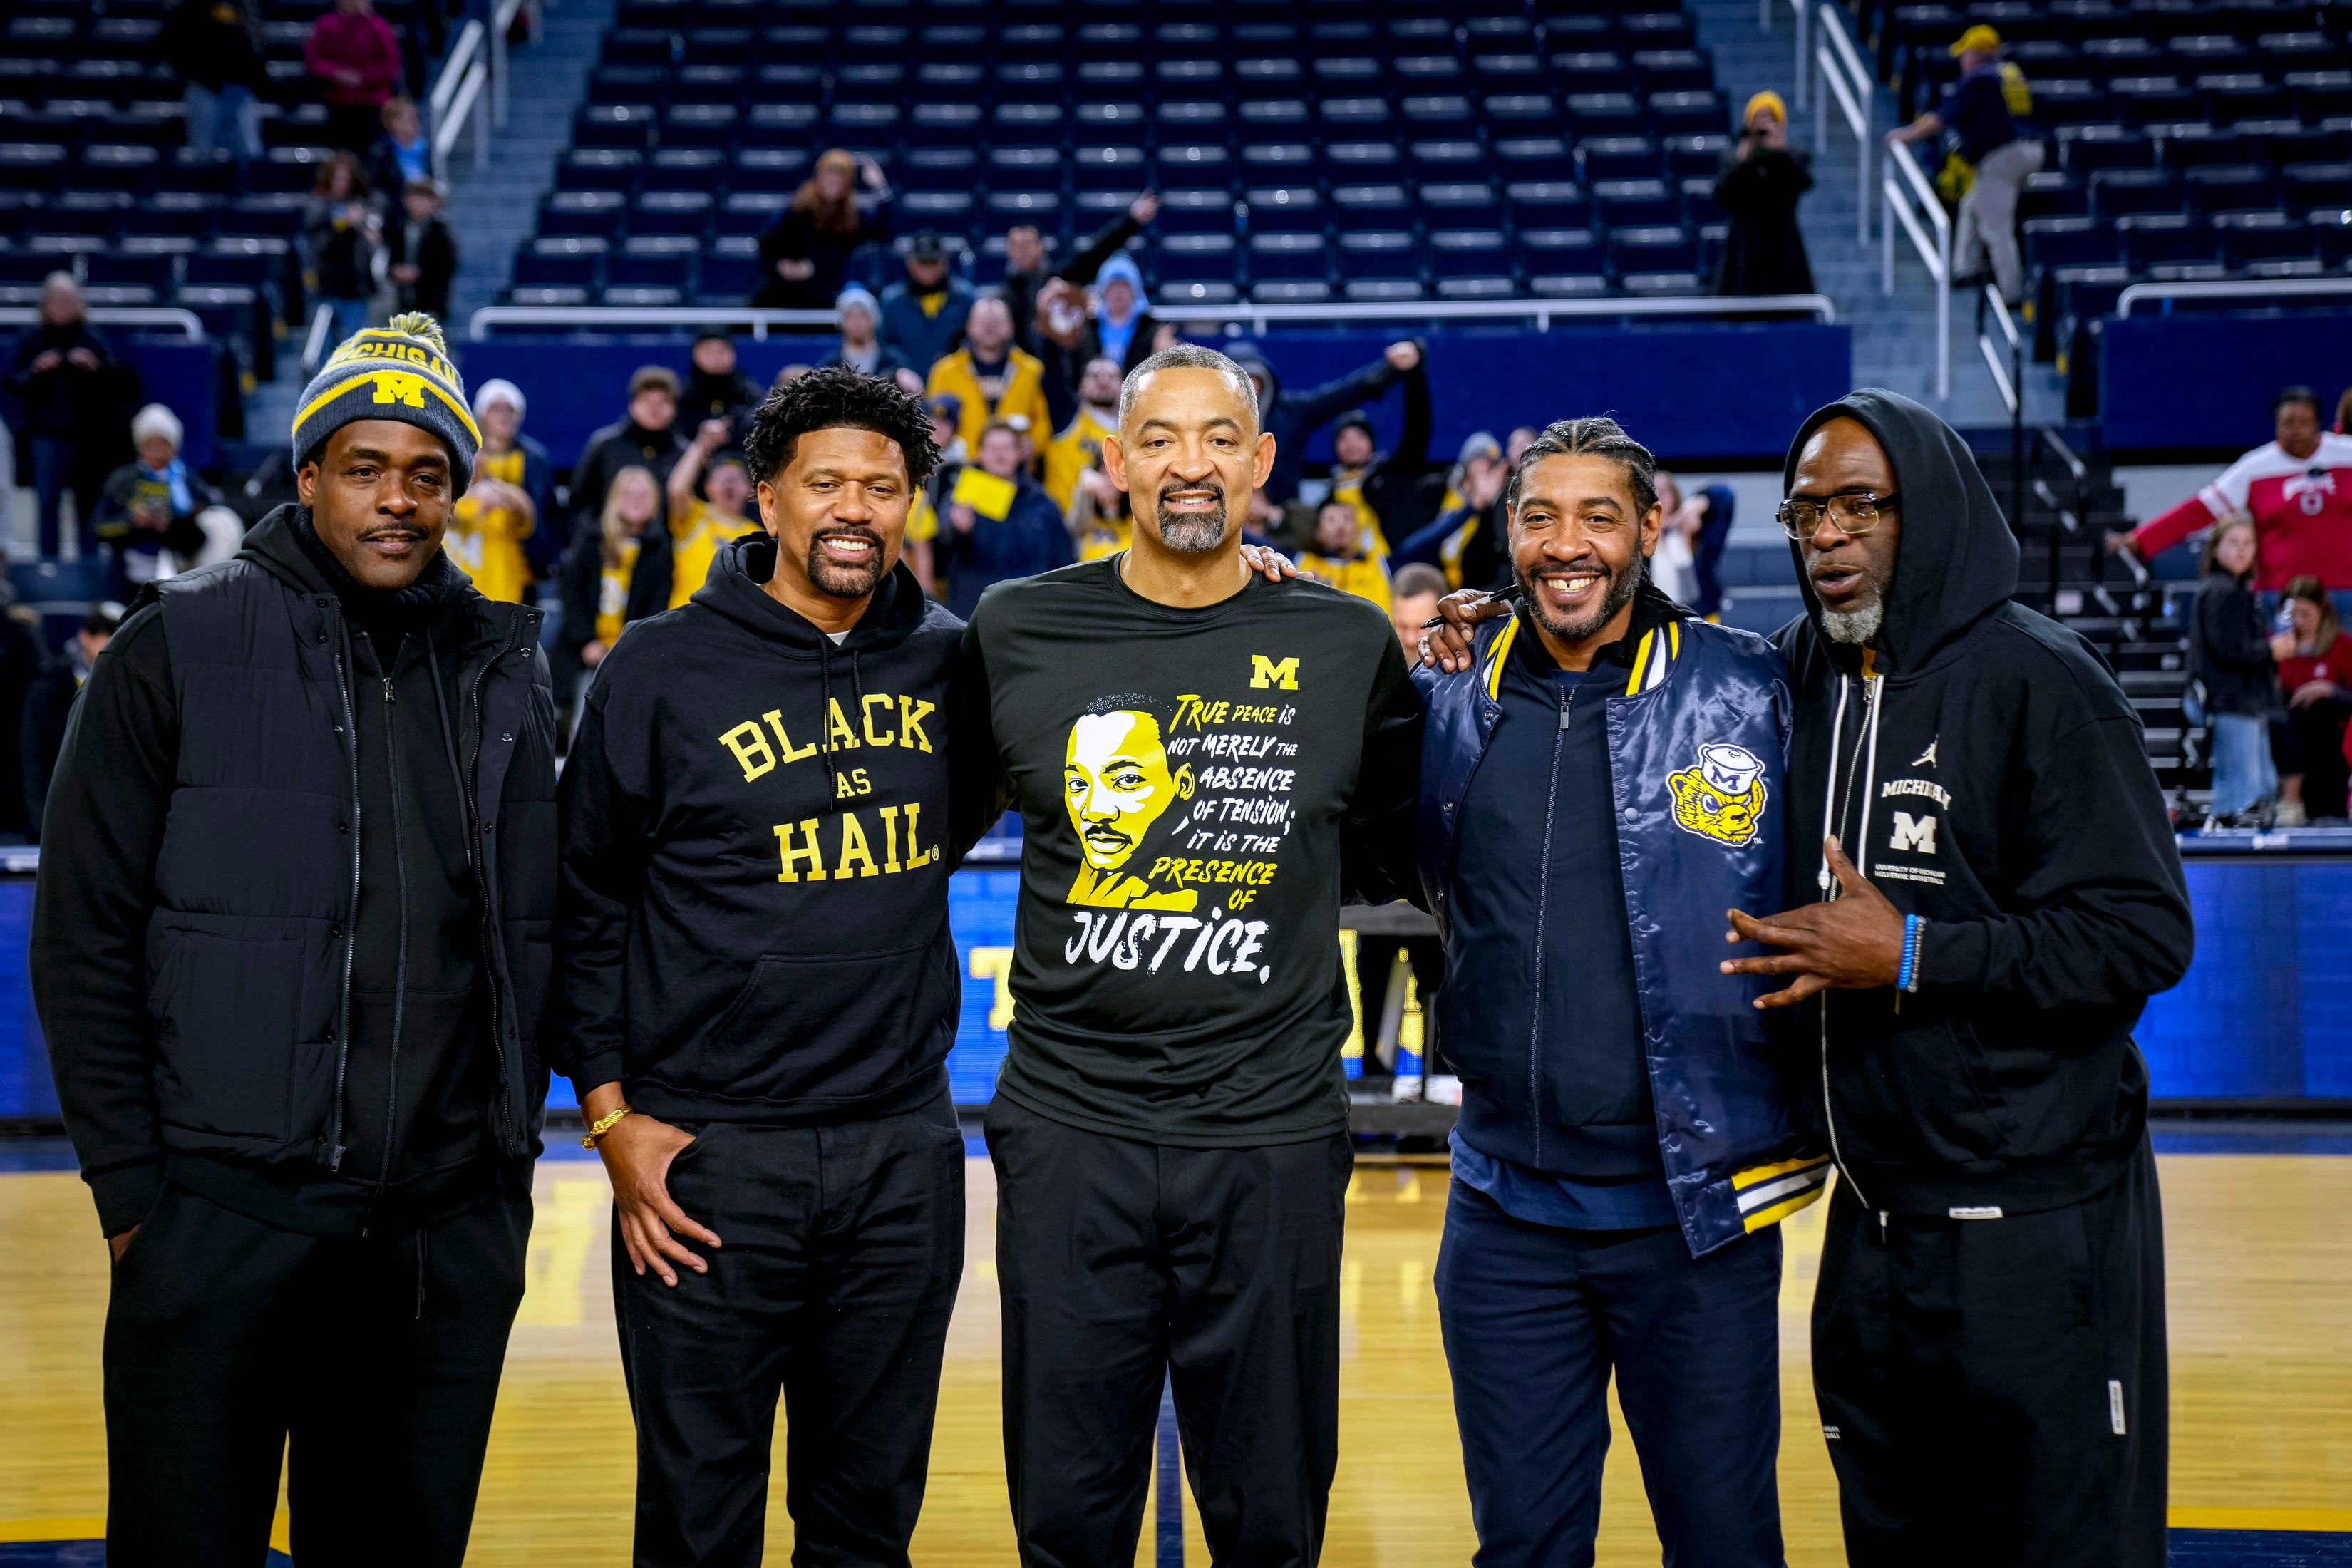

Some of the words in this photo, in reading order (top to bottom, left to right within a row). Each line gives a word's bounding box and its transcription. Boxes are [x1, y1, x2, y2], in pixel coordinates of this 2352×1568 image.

[373, 373, 425, 408] M
[1249, 654, 1300, 691] M
[1169, 694, 1231, 733] TRUE
[1232, 705, 1278, 724] PEACE
[718, 693, 936, 783] BLACK
[1167, 736, 1201, 757] NOT
[1202, 733, 1277, 763] MERELY
[1275, 743, 1299, 756] THE
[837, 768, 872, 799] AS
[1199, 766, 1296, 793] ABSENCE
[1711, 765, 1740, 791] M
[1192, 799, 1217, 821] OF
[1239, 835, 1281, 853] THE
[1889, 810, 1937, 855] M
[1148, 856, 1279, 889] PRESENCE
[1874, 870, 1909, 880] WOLVERINE
[1875, 863, 1909, 873] UNIVERSITY
[1228, 888, 1257, 911] OF
